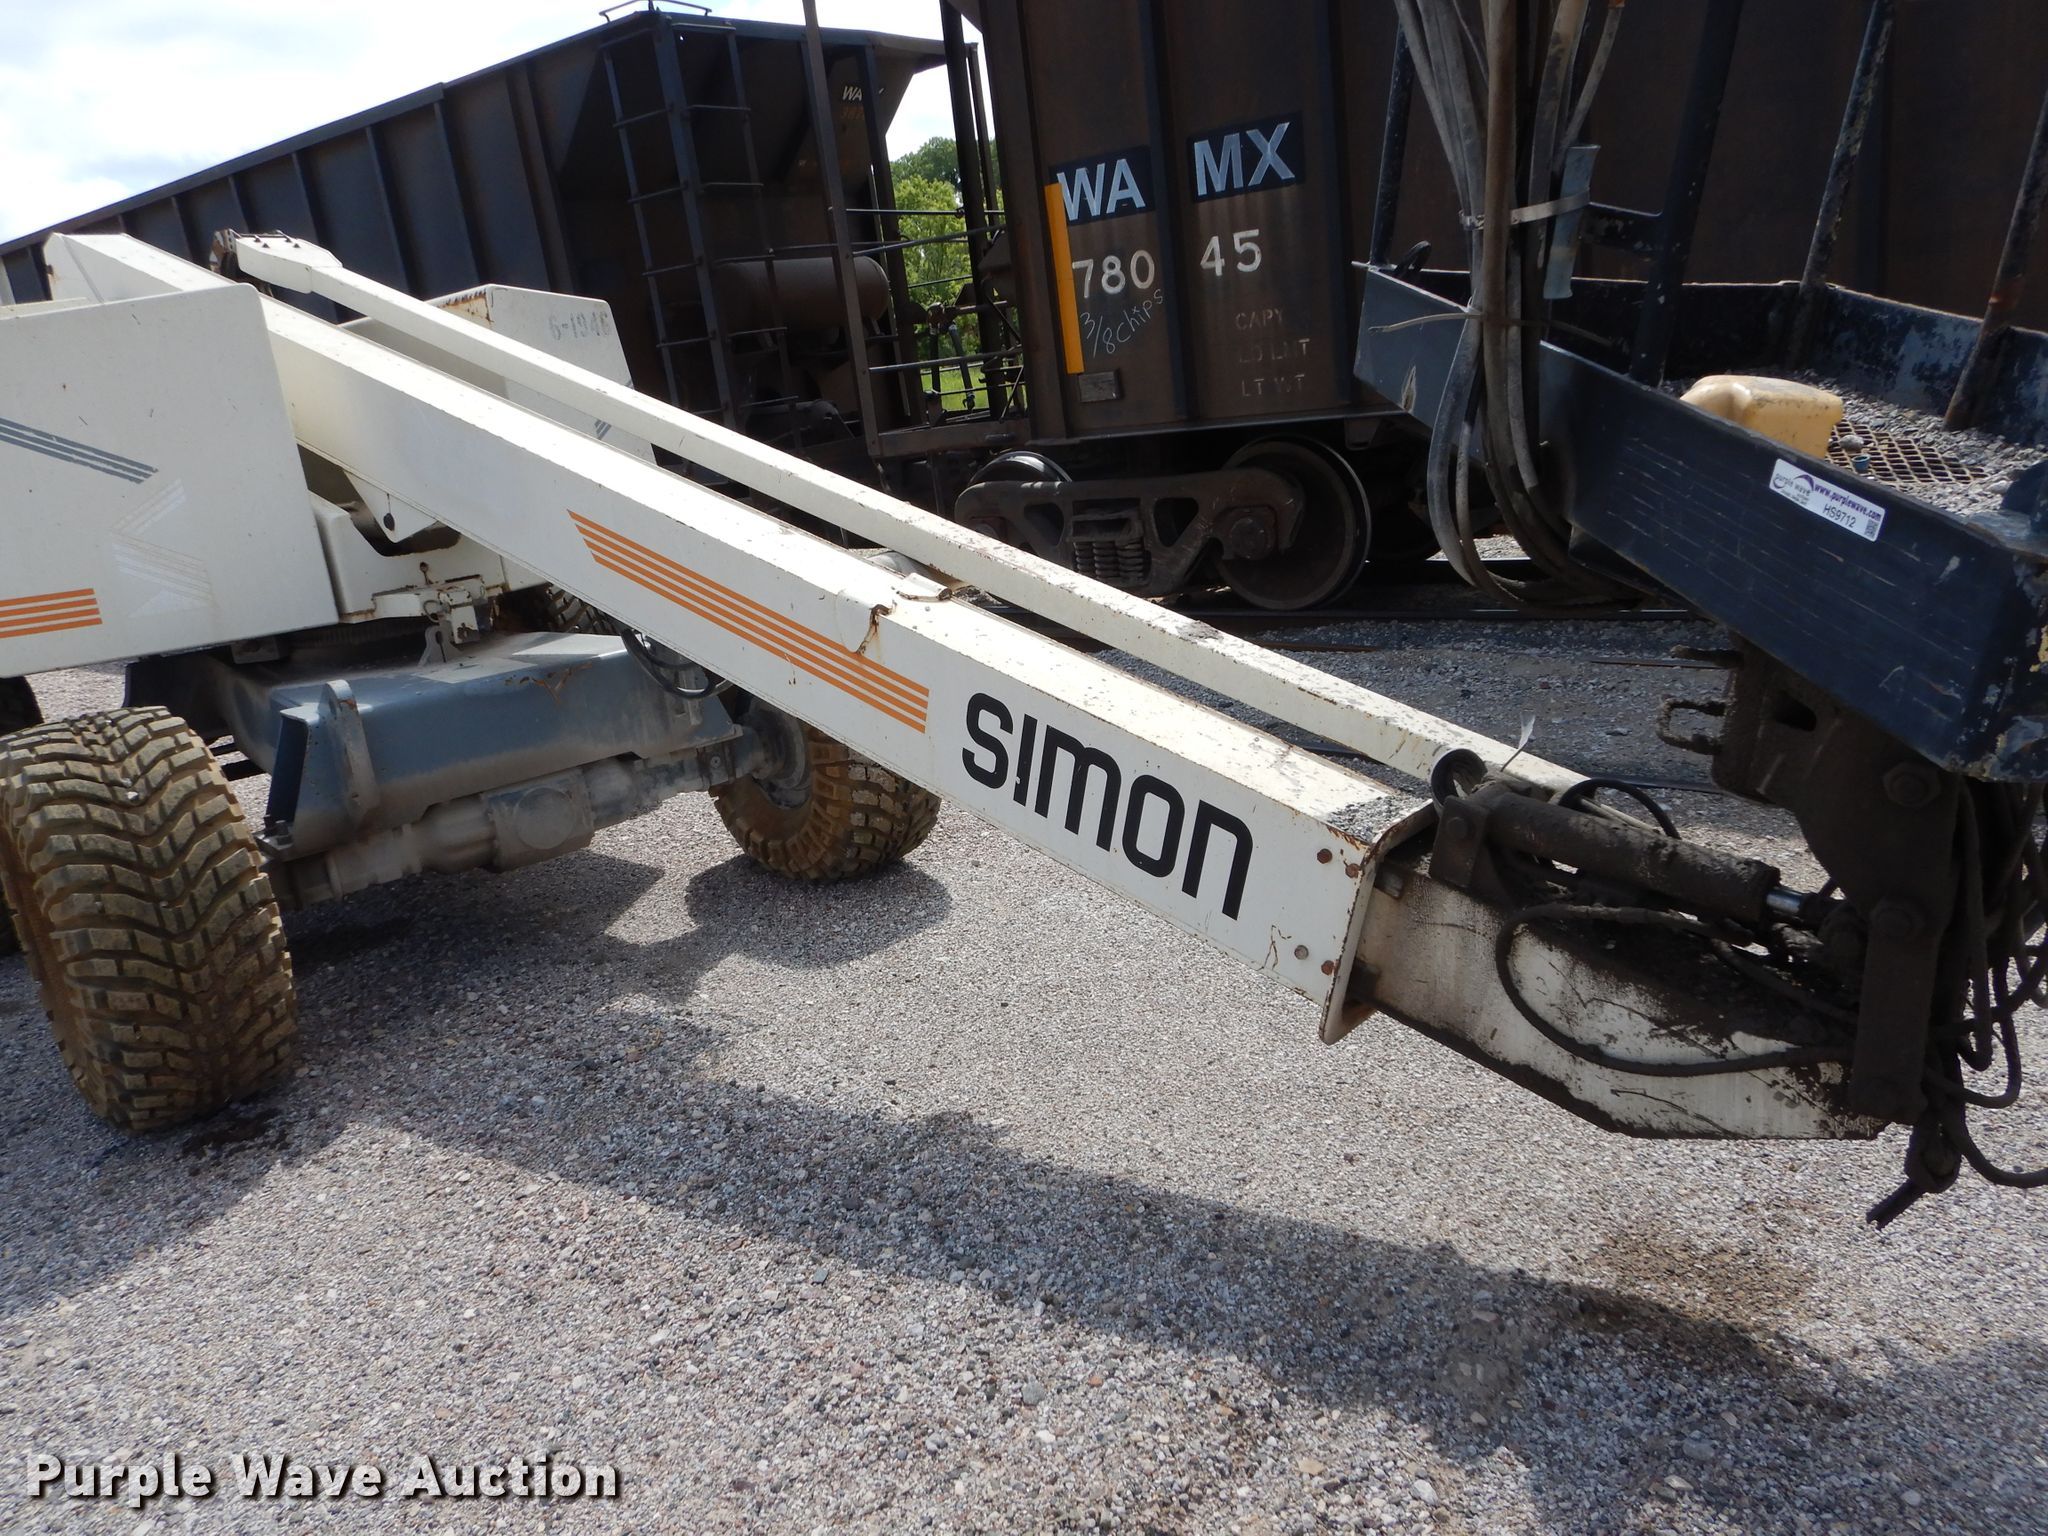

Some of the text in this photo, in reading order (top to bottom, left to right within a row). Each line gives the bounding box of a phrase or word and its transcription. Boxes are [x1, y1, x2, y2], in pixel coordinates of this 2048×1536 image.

[1057, 122, 1296, 222] WA MX
[1072, 229, 1262, 299] 780 45
[1814, 483, 1882, 522] www.purplewave.com
[1823, 504, 1856, 528] HS9712
